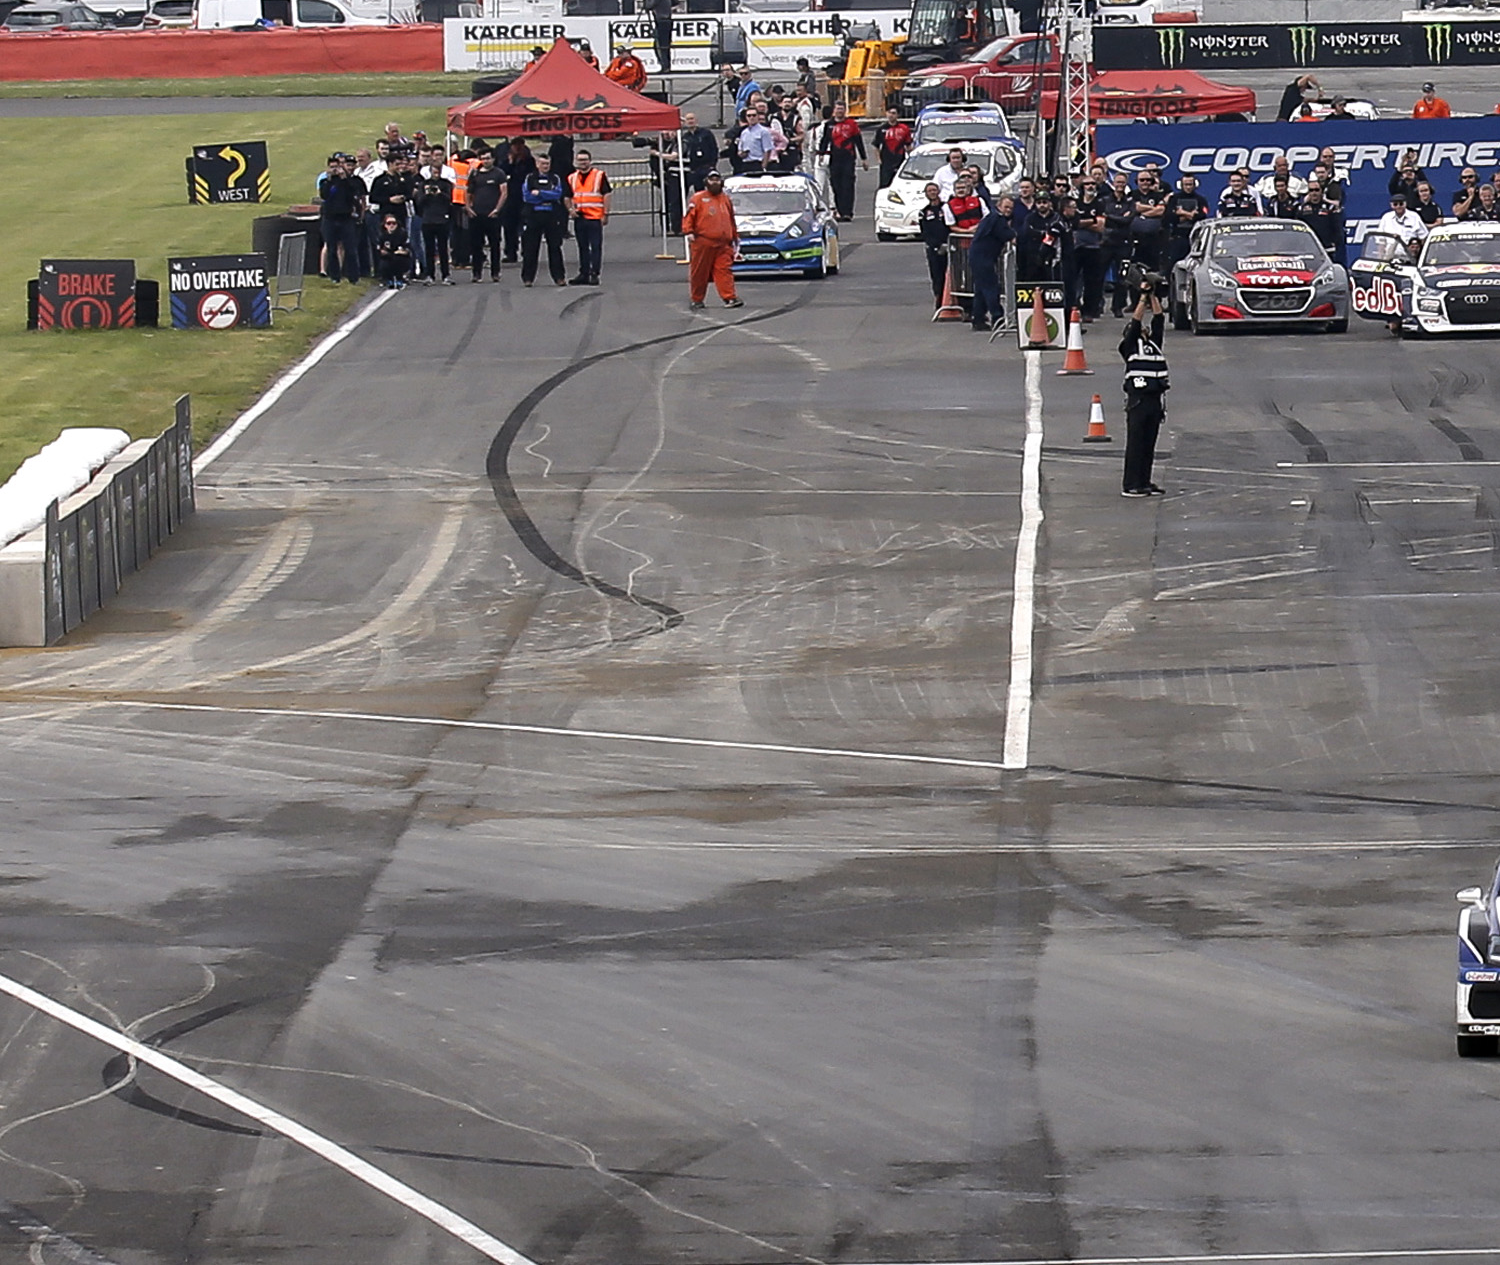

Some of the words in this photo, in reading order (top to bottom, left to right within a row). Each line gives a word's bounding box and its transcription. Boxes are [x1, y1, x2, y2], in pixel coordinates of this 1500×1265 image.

[464, 24, 566, 40] KÄRCHER
[612, 20, 710, 38] KÄRHER
[1190, 34, 1269, 50] MONSTER
[1322, 32, 1401, 46] MONSTER
[217, 187, 250, 202] WEST
[57, 274, 116, 296] BRAKE
[170, 273, 190, 292] NO
[195, 269, 265, 291] OVERTAKE
[1246, 274, 1304, 285] TOTAL
[1253, 294, 1300, 309] 208
